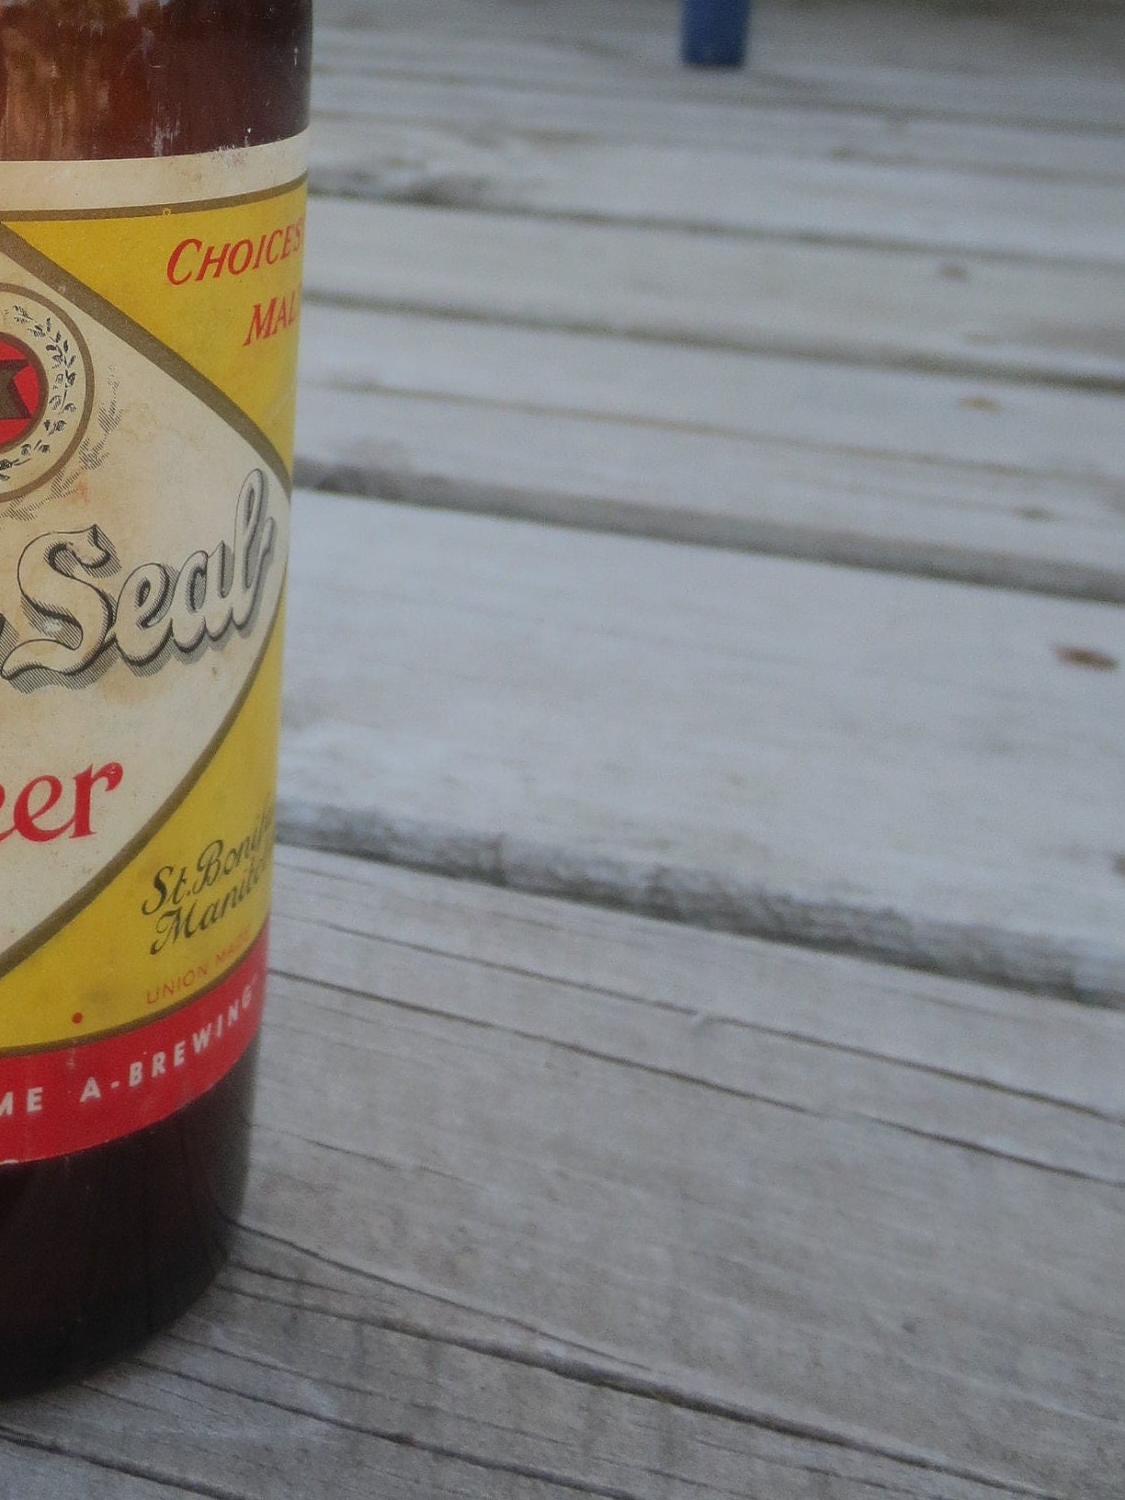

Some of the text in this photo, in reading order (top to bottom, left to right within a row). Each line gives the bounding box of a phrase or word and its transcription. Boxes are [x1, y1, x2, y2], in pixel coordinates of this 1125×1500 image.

[165, 216, 305, 286] CHOICES
[242, 283, 302, 346] MAL
[1, 468, 278, 689] Seal
[141, 865, 191, 916] St.
[146, 964, 209, 1004] UNION
